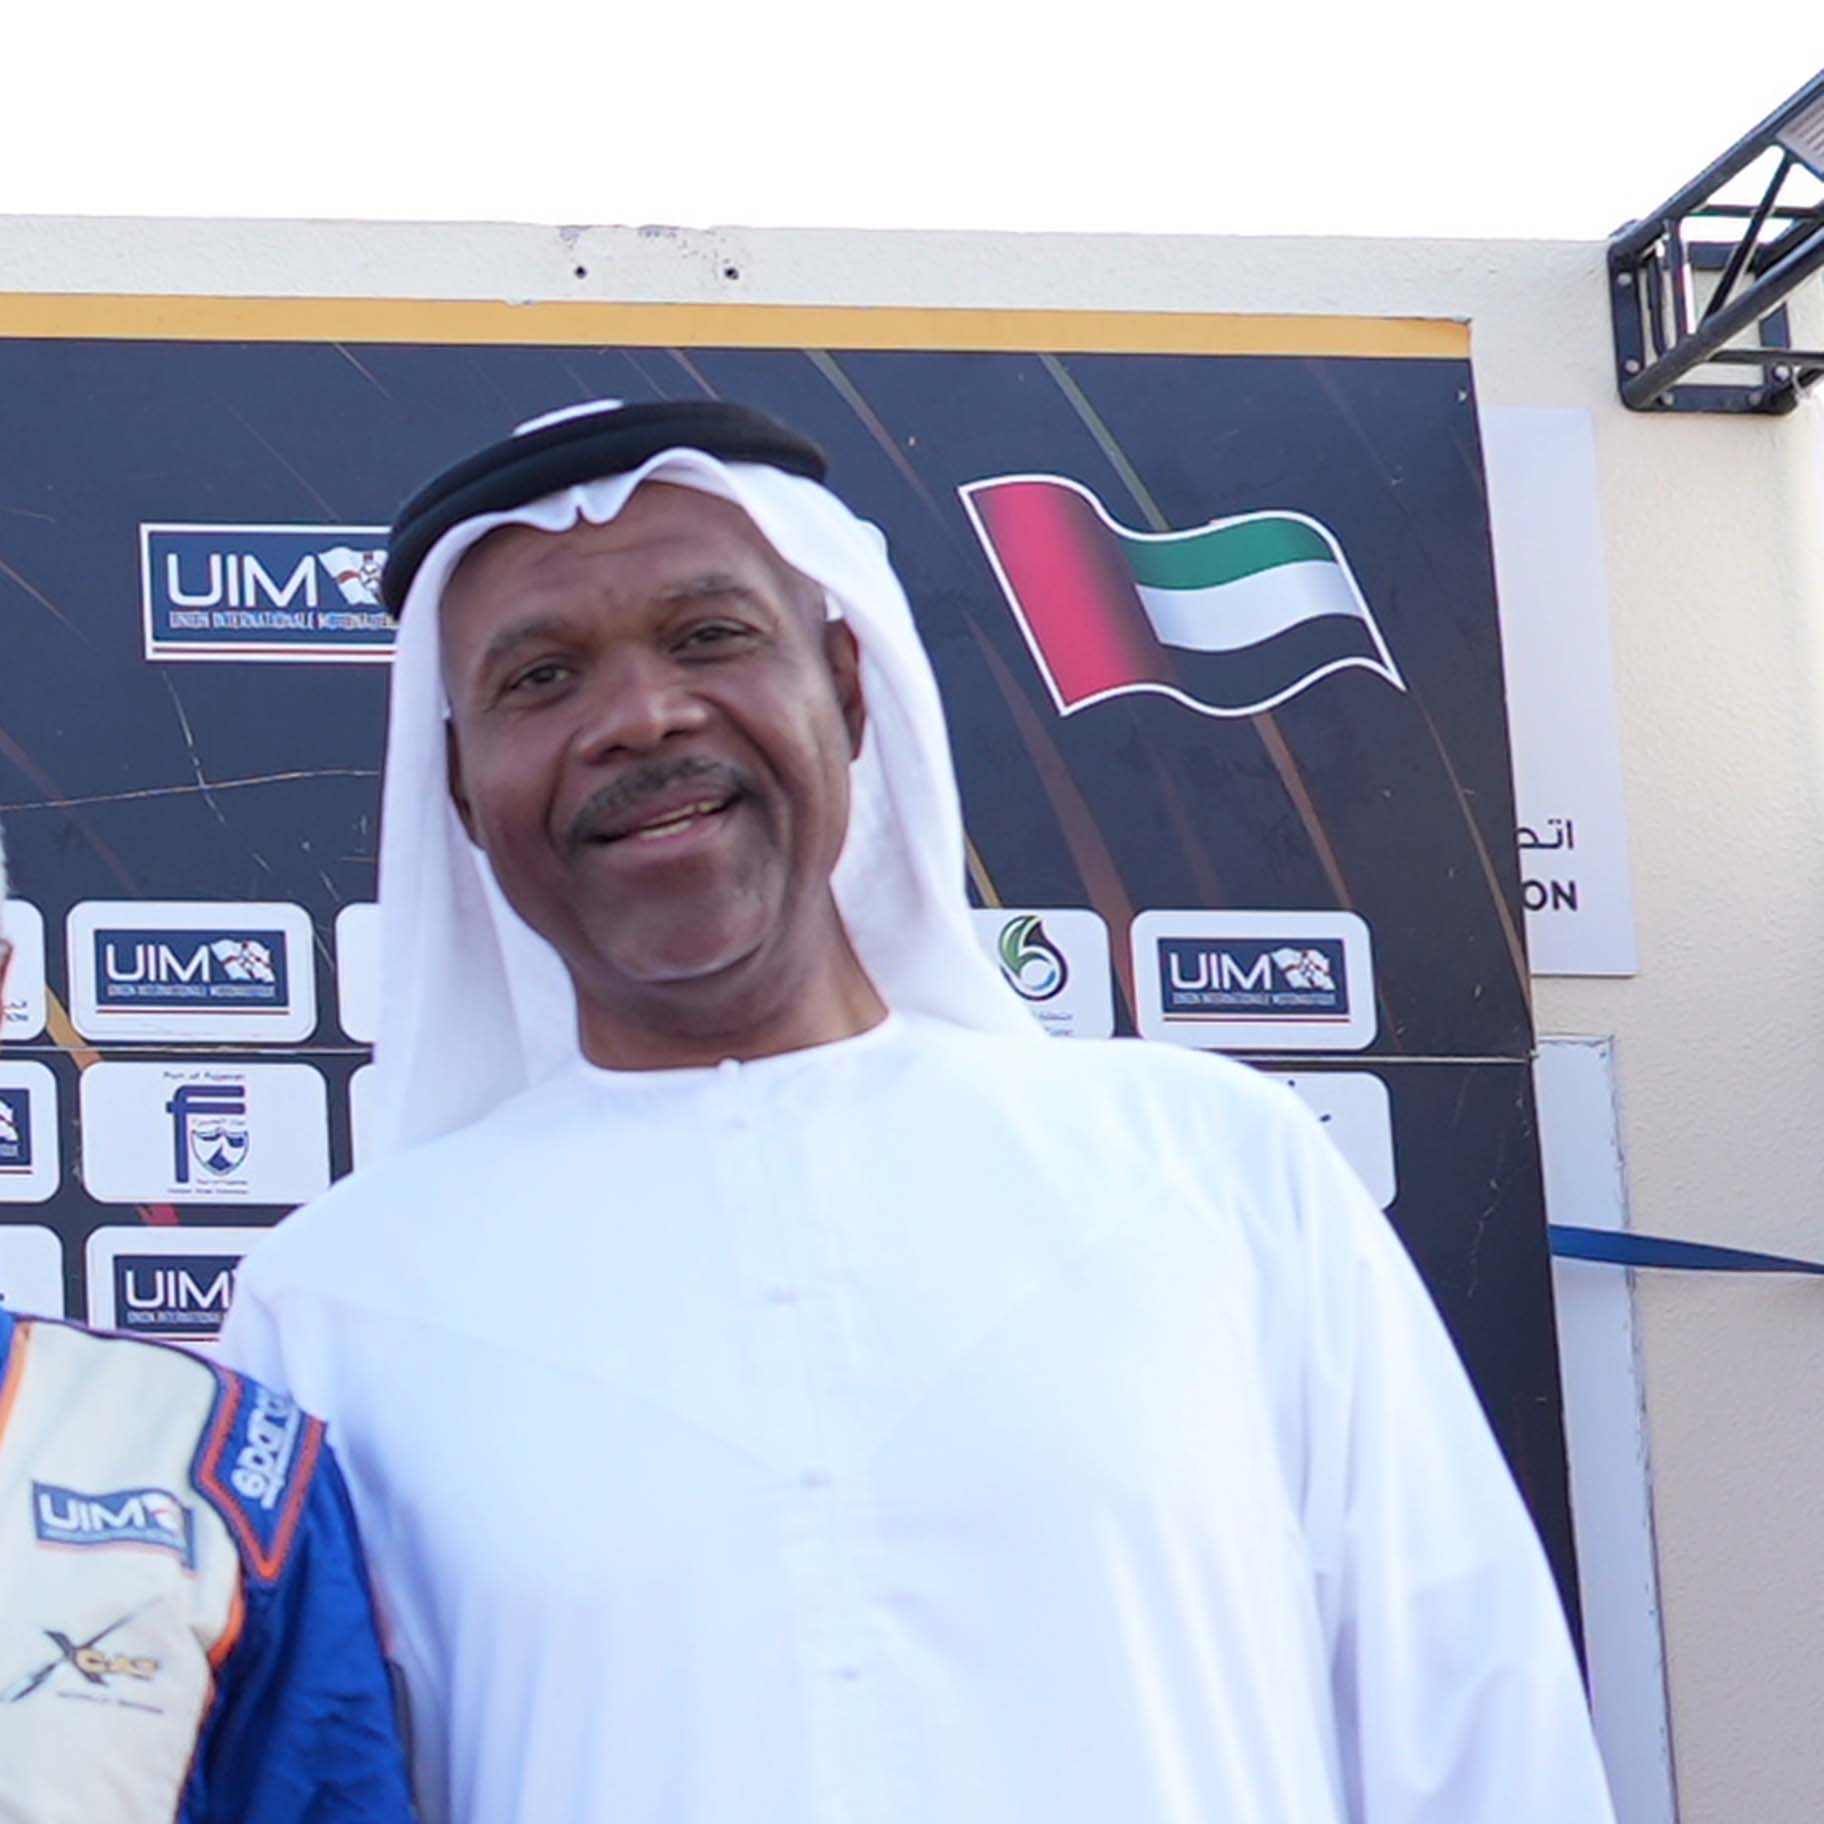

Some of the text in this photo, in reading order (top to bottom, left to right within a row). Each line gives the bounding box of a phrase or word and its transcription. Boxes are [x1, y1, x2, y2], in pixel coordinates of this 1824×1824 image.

[167, 553, 318, 607] UIM
[107, 944, 211, 982] UIM
[1170, 952, 1272, 990] UIM
[125, 1269, 229, 1308] UIM
[39, 1493, 146, 1531] UIM
